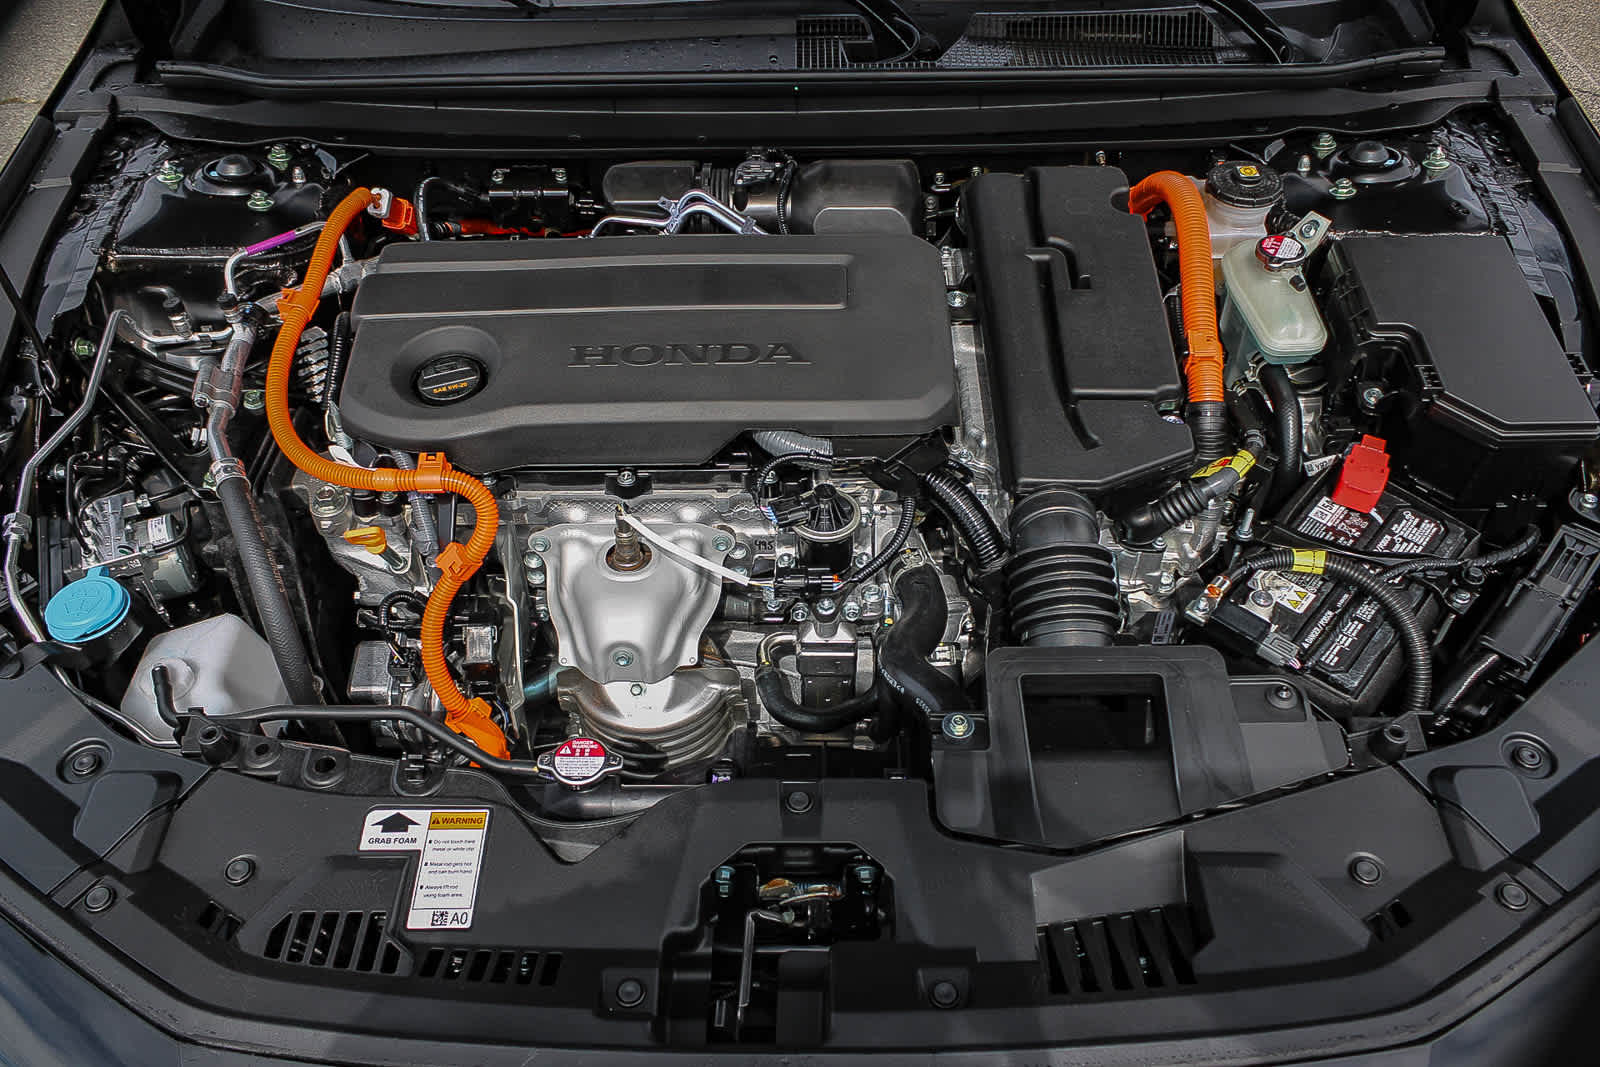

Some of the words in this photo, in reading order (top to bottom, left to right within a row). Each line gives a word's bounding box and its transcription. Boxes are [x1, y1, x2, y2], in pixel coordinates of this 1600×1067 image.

[567, 343, 812, 368] HONDA
[432, 386, 447, 394] SAE
[441, 817, 484, 825] WARNING
[368, 837, 391, 845] GRAB
[450, 911, 468, 925] A0
